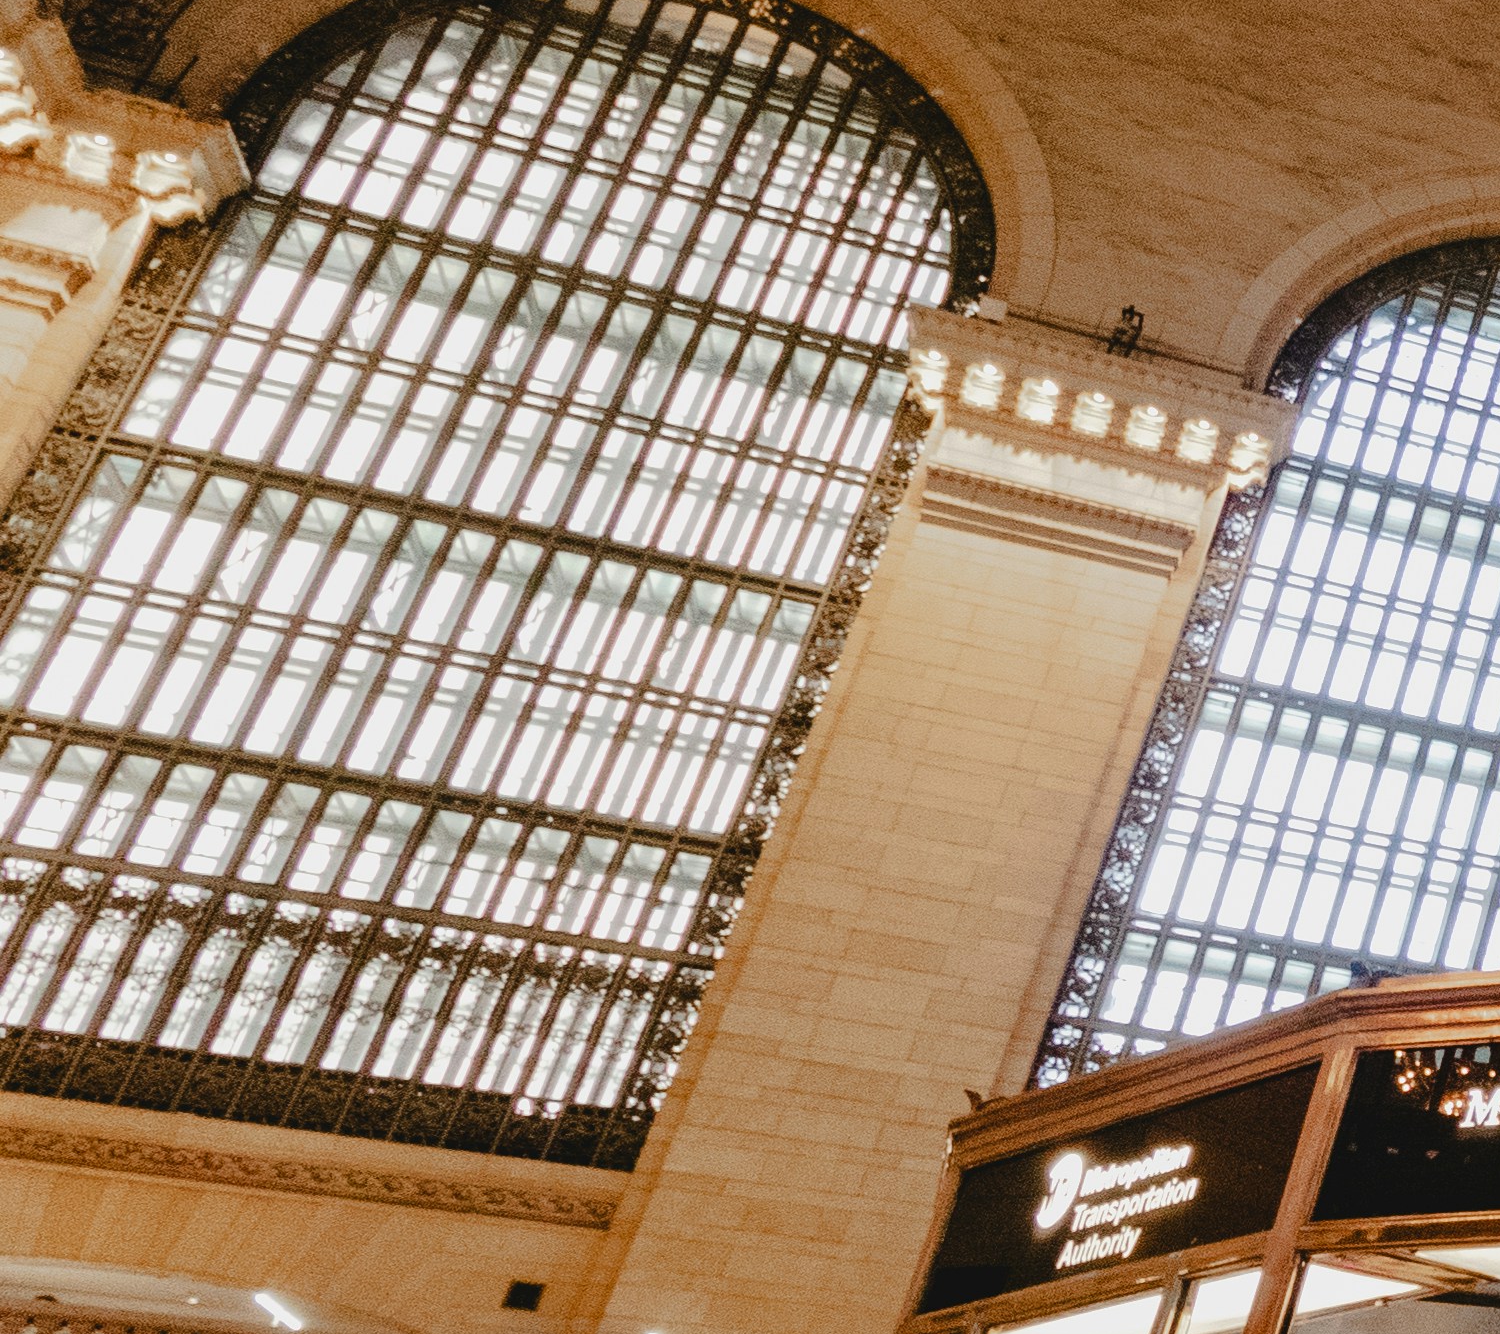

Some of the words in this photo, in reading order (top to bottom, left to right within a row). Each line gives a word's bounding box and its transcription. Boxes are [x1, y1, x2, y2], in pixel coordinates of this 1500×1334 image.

[1080, 1145, 1191, 1197] Metropolitan
[1071, 1176, 1199, 1233] Transportation
[1055, 1224, 1142, 1270] Authority
